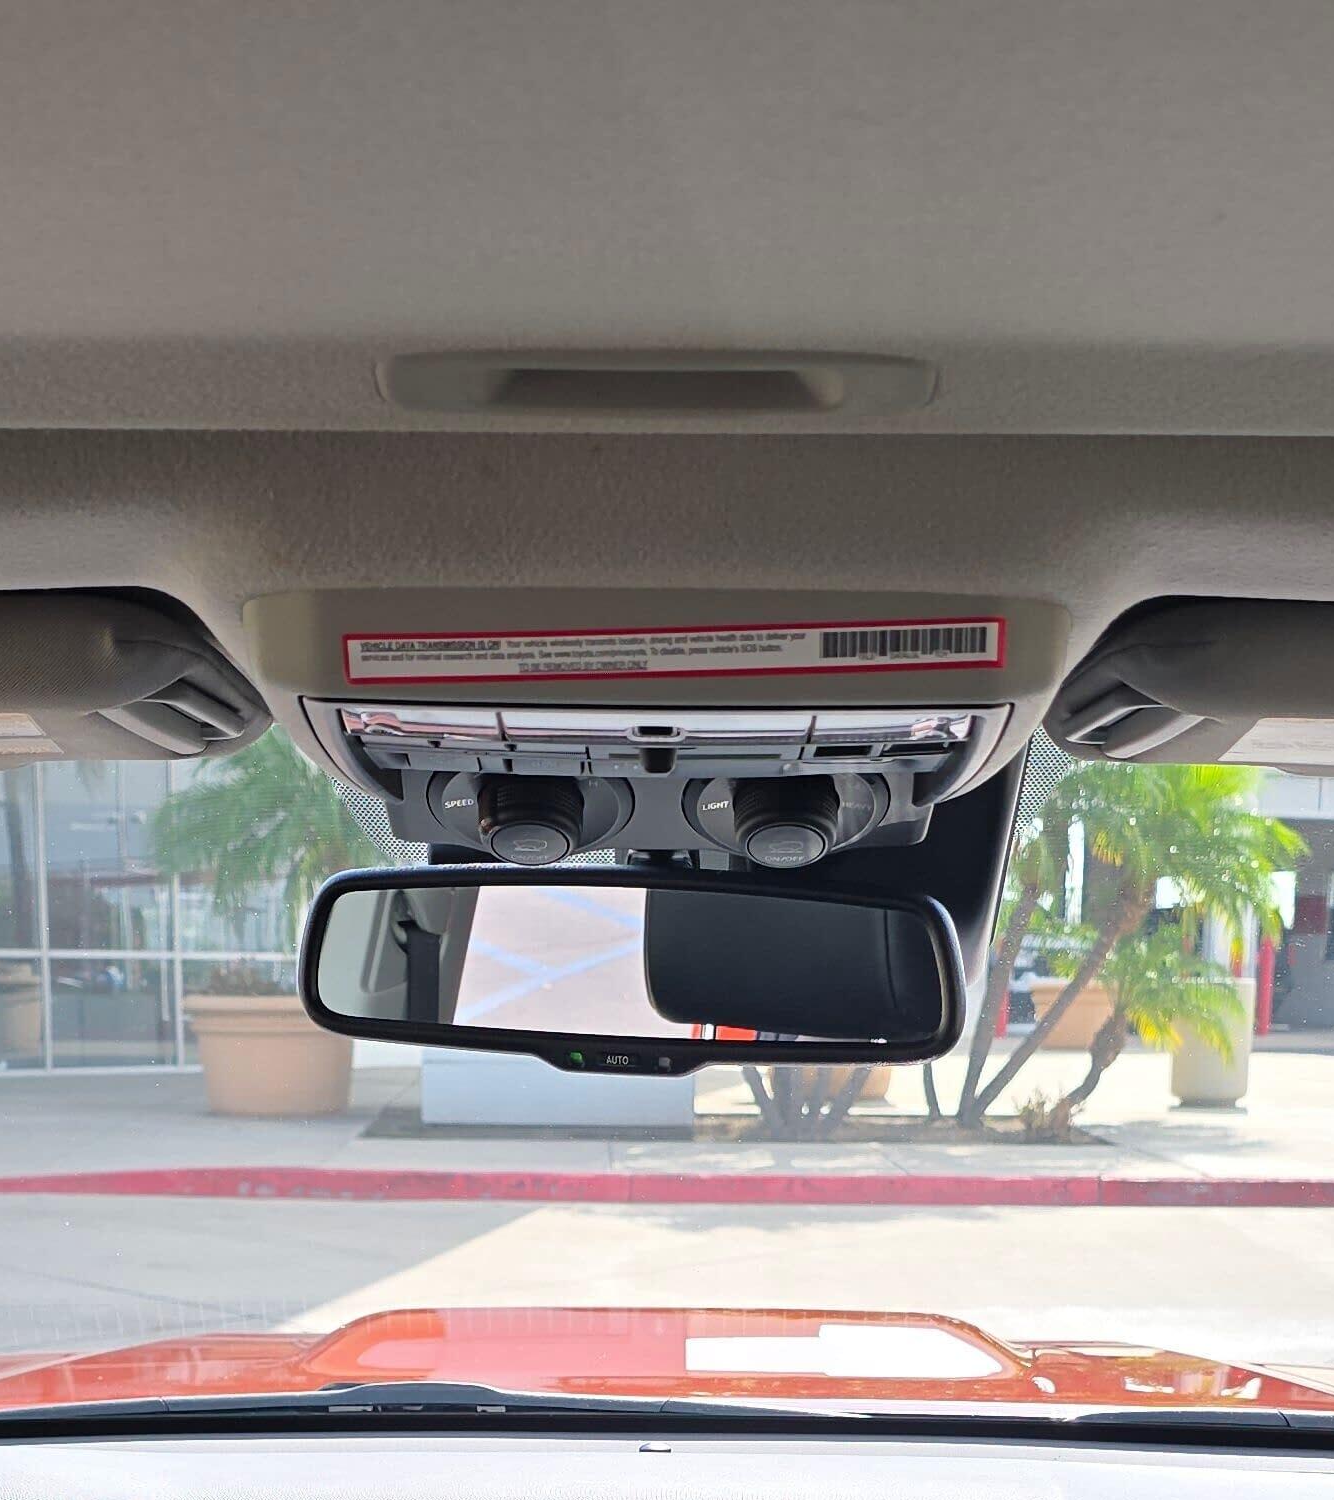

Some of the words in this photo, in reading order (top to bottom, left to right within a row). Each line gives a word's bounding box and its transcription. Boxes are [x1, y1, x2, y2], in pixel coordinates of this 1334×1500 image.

[444, 798, 474, 809] SPEED
[702, 800, 729, 811] LIGHT
[606, 1055, 630, 1066] AUTO
